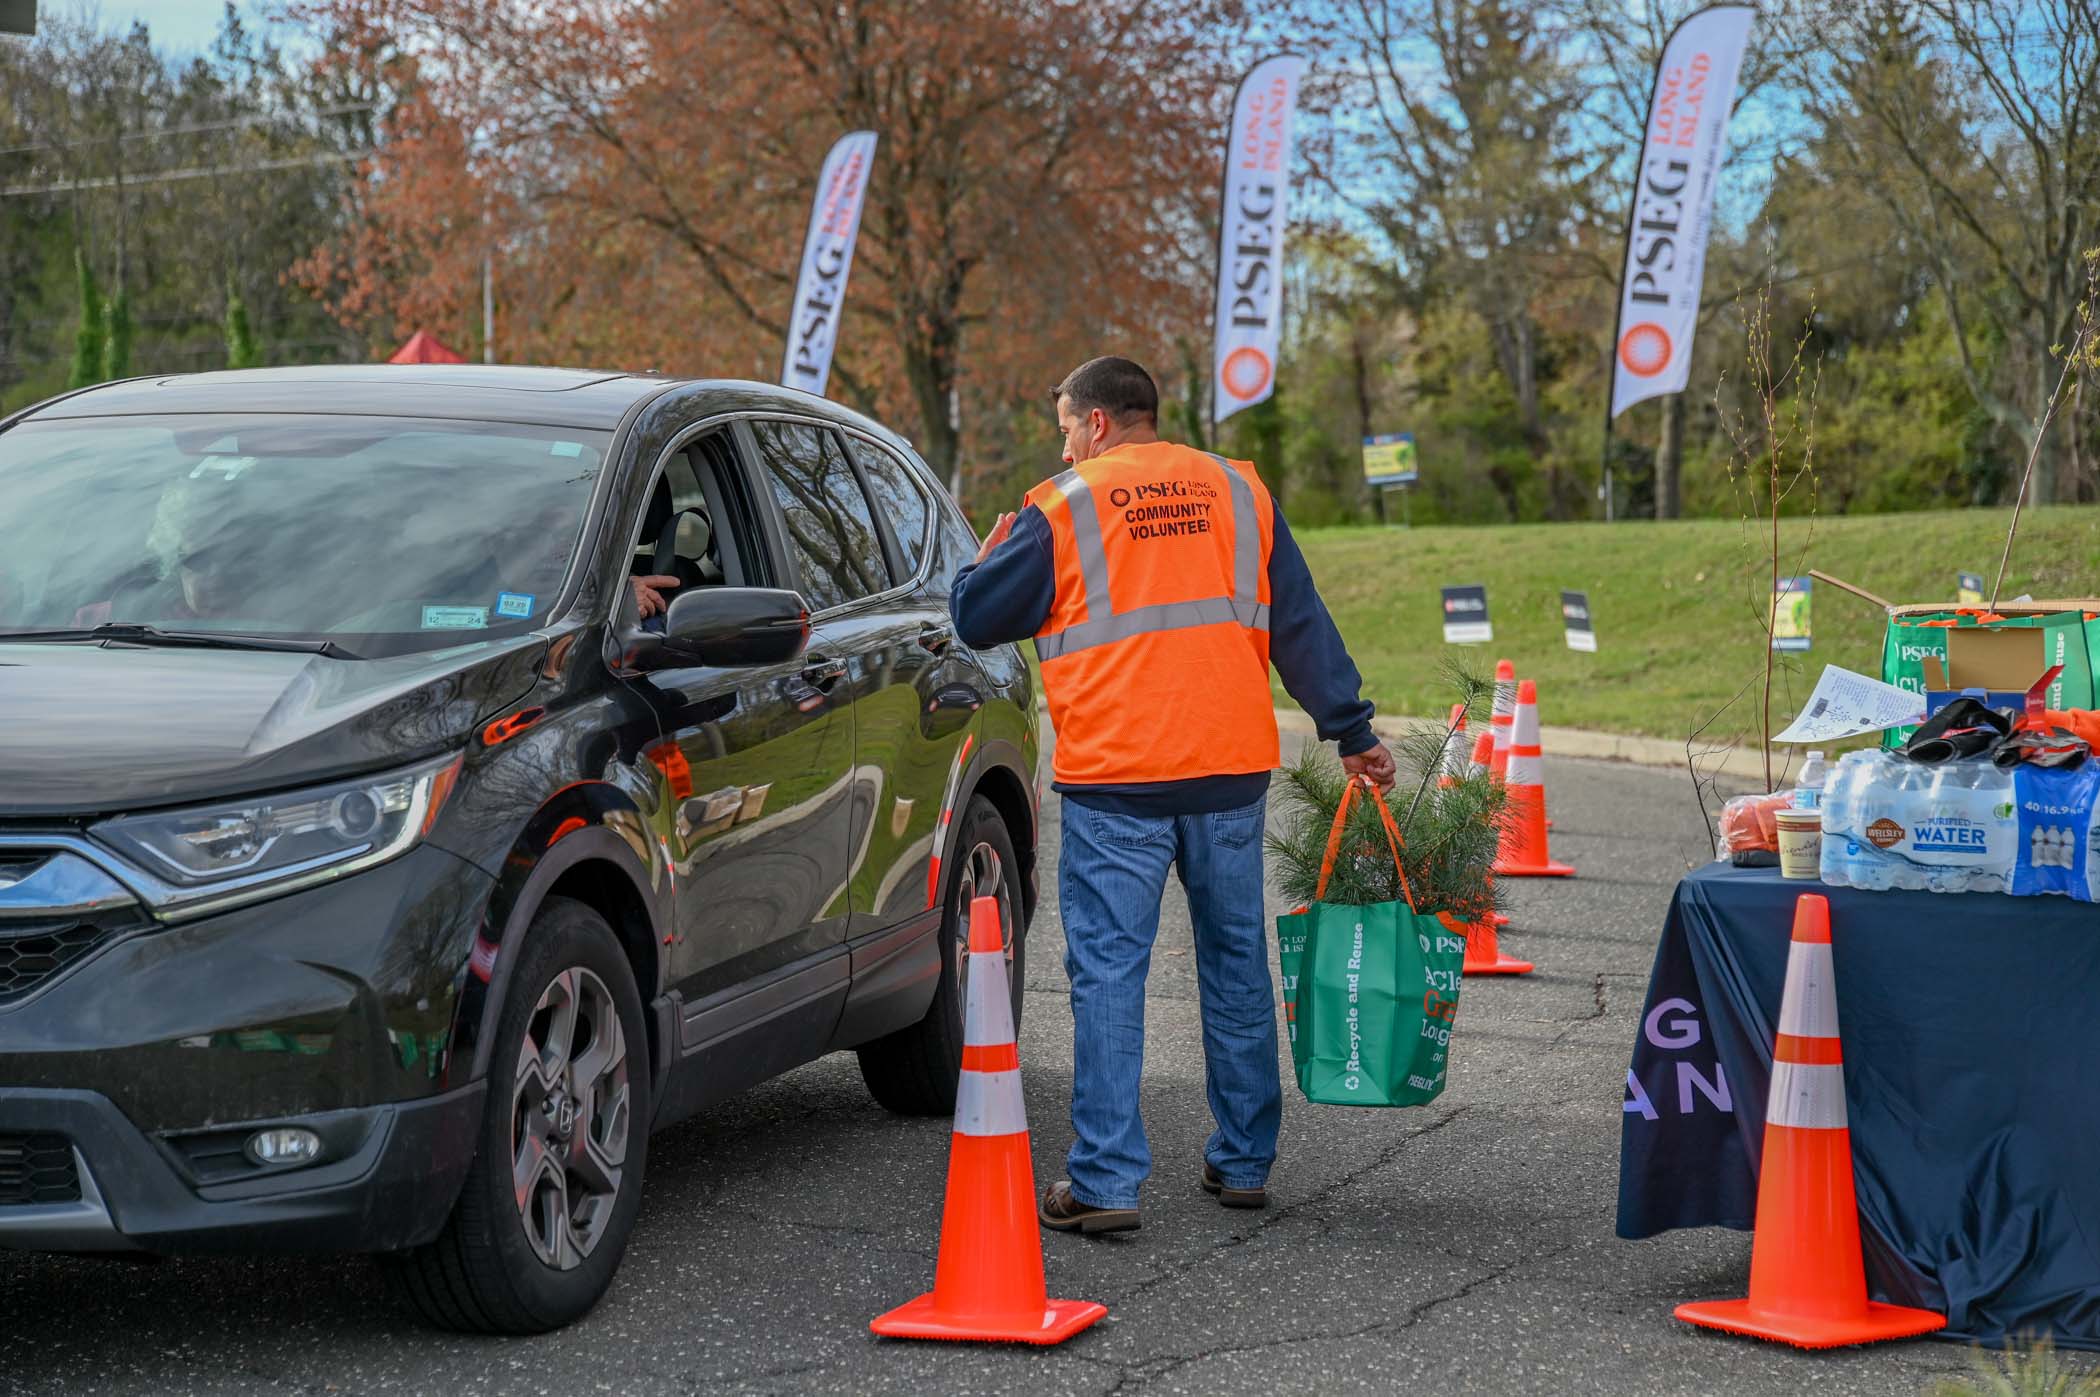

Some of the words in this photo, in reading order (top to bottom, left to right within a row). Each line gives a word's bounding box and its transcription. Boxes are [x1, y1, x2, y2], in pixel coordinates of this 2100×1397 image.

[1653, 66, 1684, 145] LONG
[1676, 52, 1712, 149] ISLAND
[1241, 93, 1265, 169] LONG
[1263, 77, 1288, 172] ISLAND
[1231, 183, 1275, 328] PSEG
[1632, 159, 1690, 305] PSEG
[795, 245, 843, 377] PSEG
[1125, 503, 1211, 523] COMMUNITY
[1135, 480, 1187, 500] PSEG
[1902, 645, 1946, 662] PSEG
[2055, 632, 2065, 679] euse
[1928, 817, 1971, 826] PURIFIED
[2025, 801, 2040, 812] 40
[2044, 806, 2069, 815] 16.9
[1914, 827, 1986, 844] WATER
[1348, 922, 1364, 969] Reuse
[1347, 974, 1360, 1003] and
[1425, 966, 1435, 986] A
[1346, 1007, 1361, 1071] Recycle
[1645, 997, 1700, 1049] G
